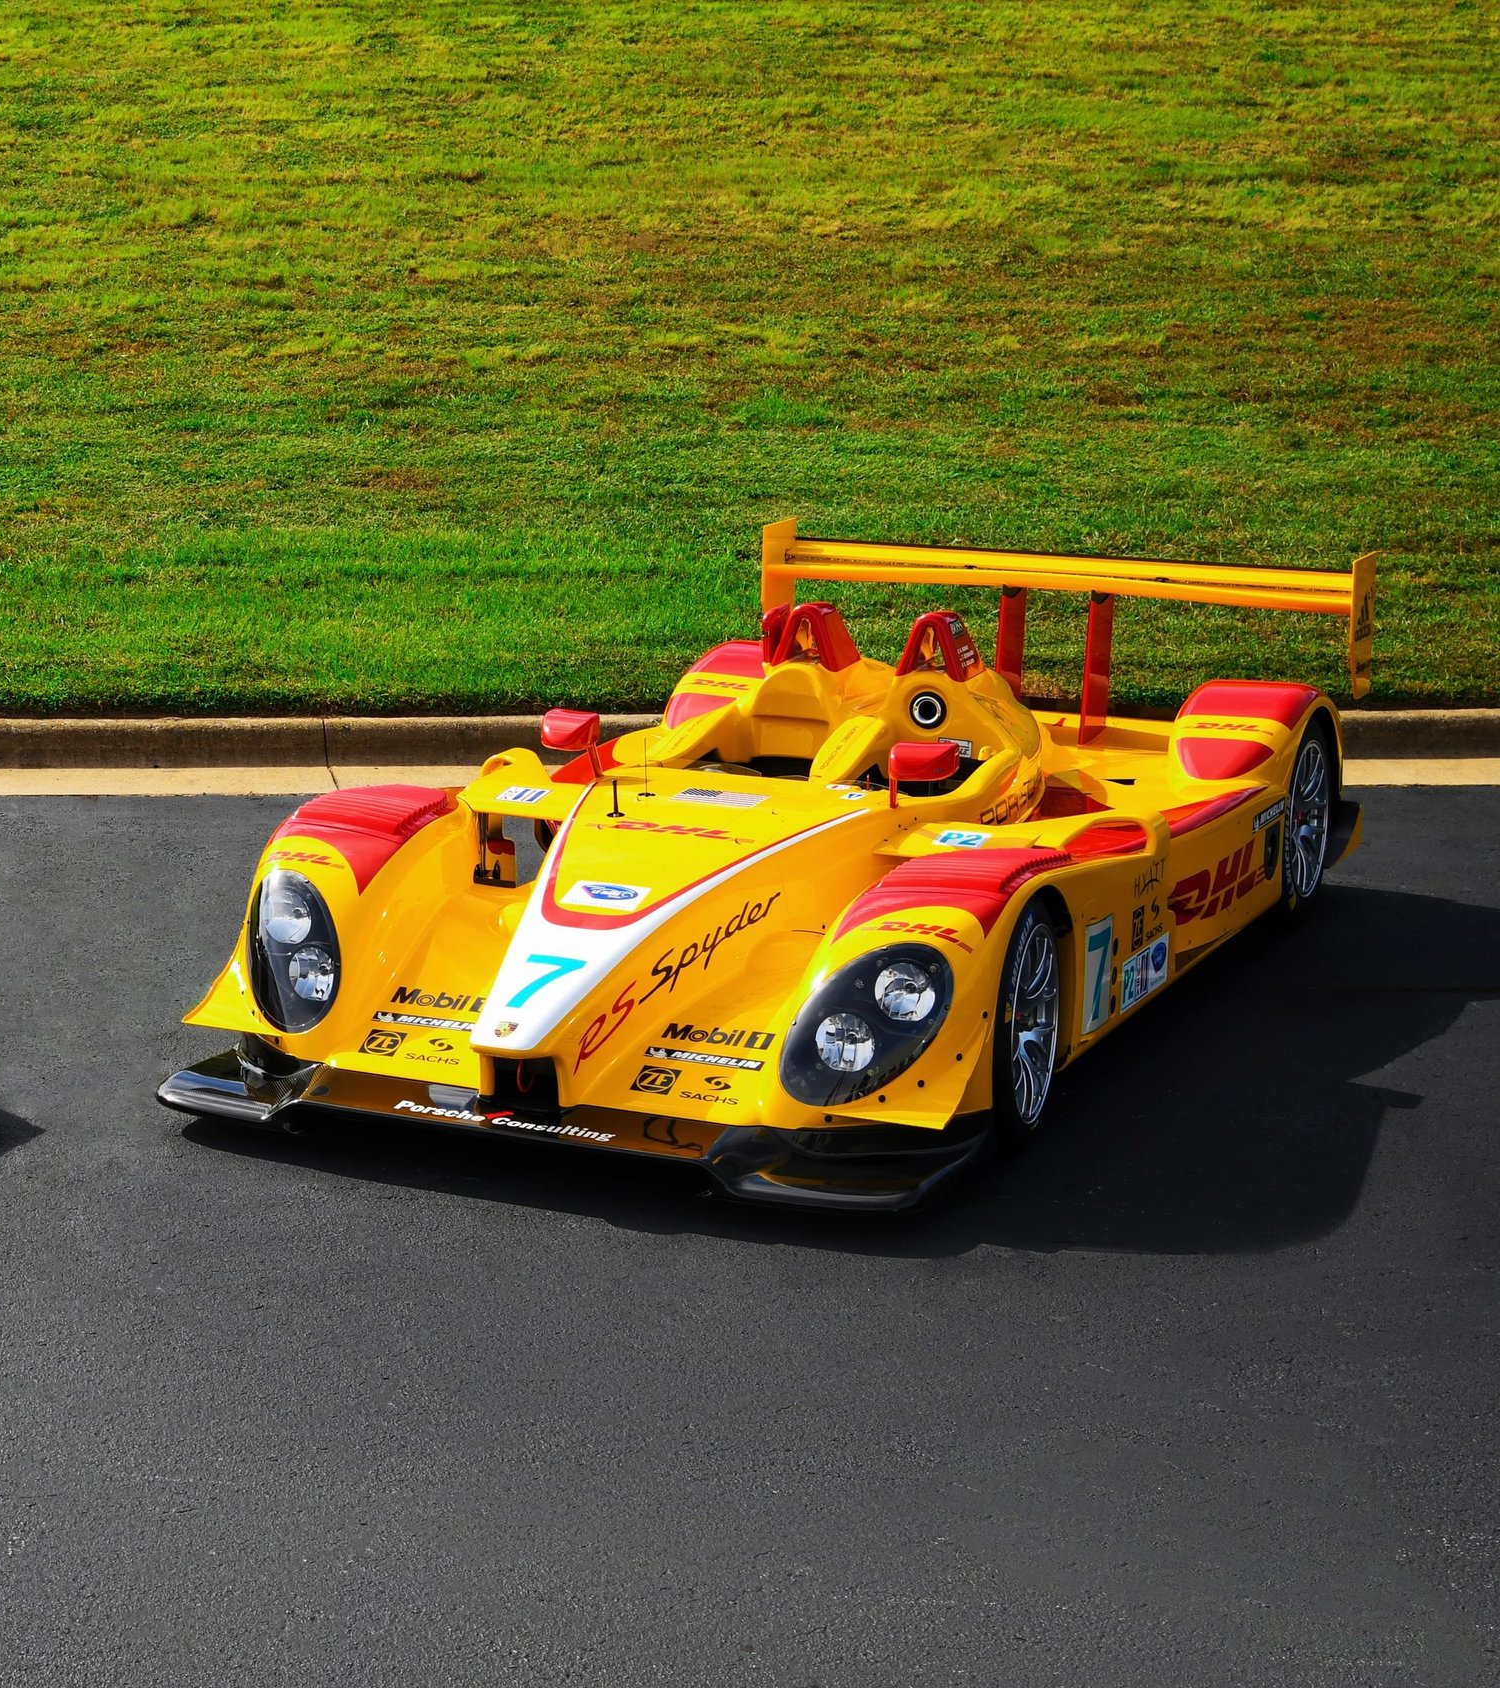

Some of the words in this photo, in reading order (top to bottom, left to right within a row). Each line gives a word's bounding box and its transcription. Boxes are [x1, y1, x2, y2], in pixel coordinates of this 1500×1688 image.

[611, 821, 733, 840] DHL
[940, 832, 983, 846] P2
[267, 850, 339, 869] DHL
[1134, 854, 1168, 899] HYATT
[1167, 838, 1258, 926] DHL
[877, 921, 964, 942] DHL
[638, 892, 781, 1005] Spyder
[505, 953, 588, 1009] 7
[1088, 926, 1112, 1022] 7
[1123, 967, 1135, 1004] P2
[390, 986, 471, 1011] Mobil
[366, 1035, 397, 1049] ZF
[661, 1023, 744, 1047] Mobil
[404, 1051, 461, 1066] SACHS
[670, 1050, 762, 1070] MICHELIN
[641, 1074, 671, 1088] ZF
[679, 1090, 739, 1106] SACHS
[394, 1099, 487, 1122] Porsche
[491, 1116, 617, 1143] Consulting
